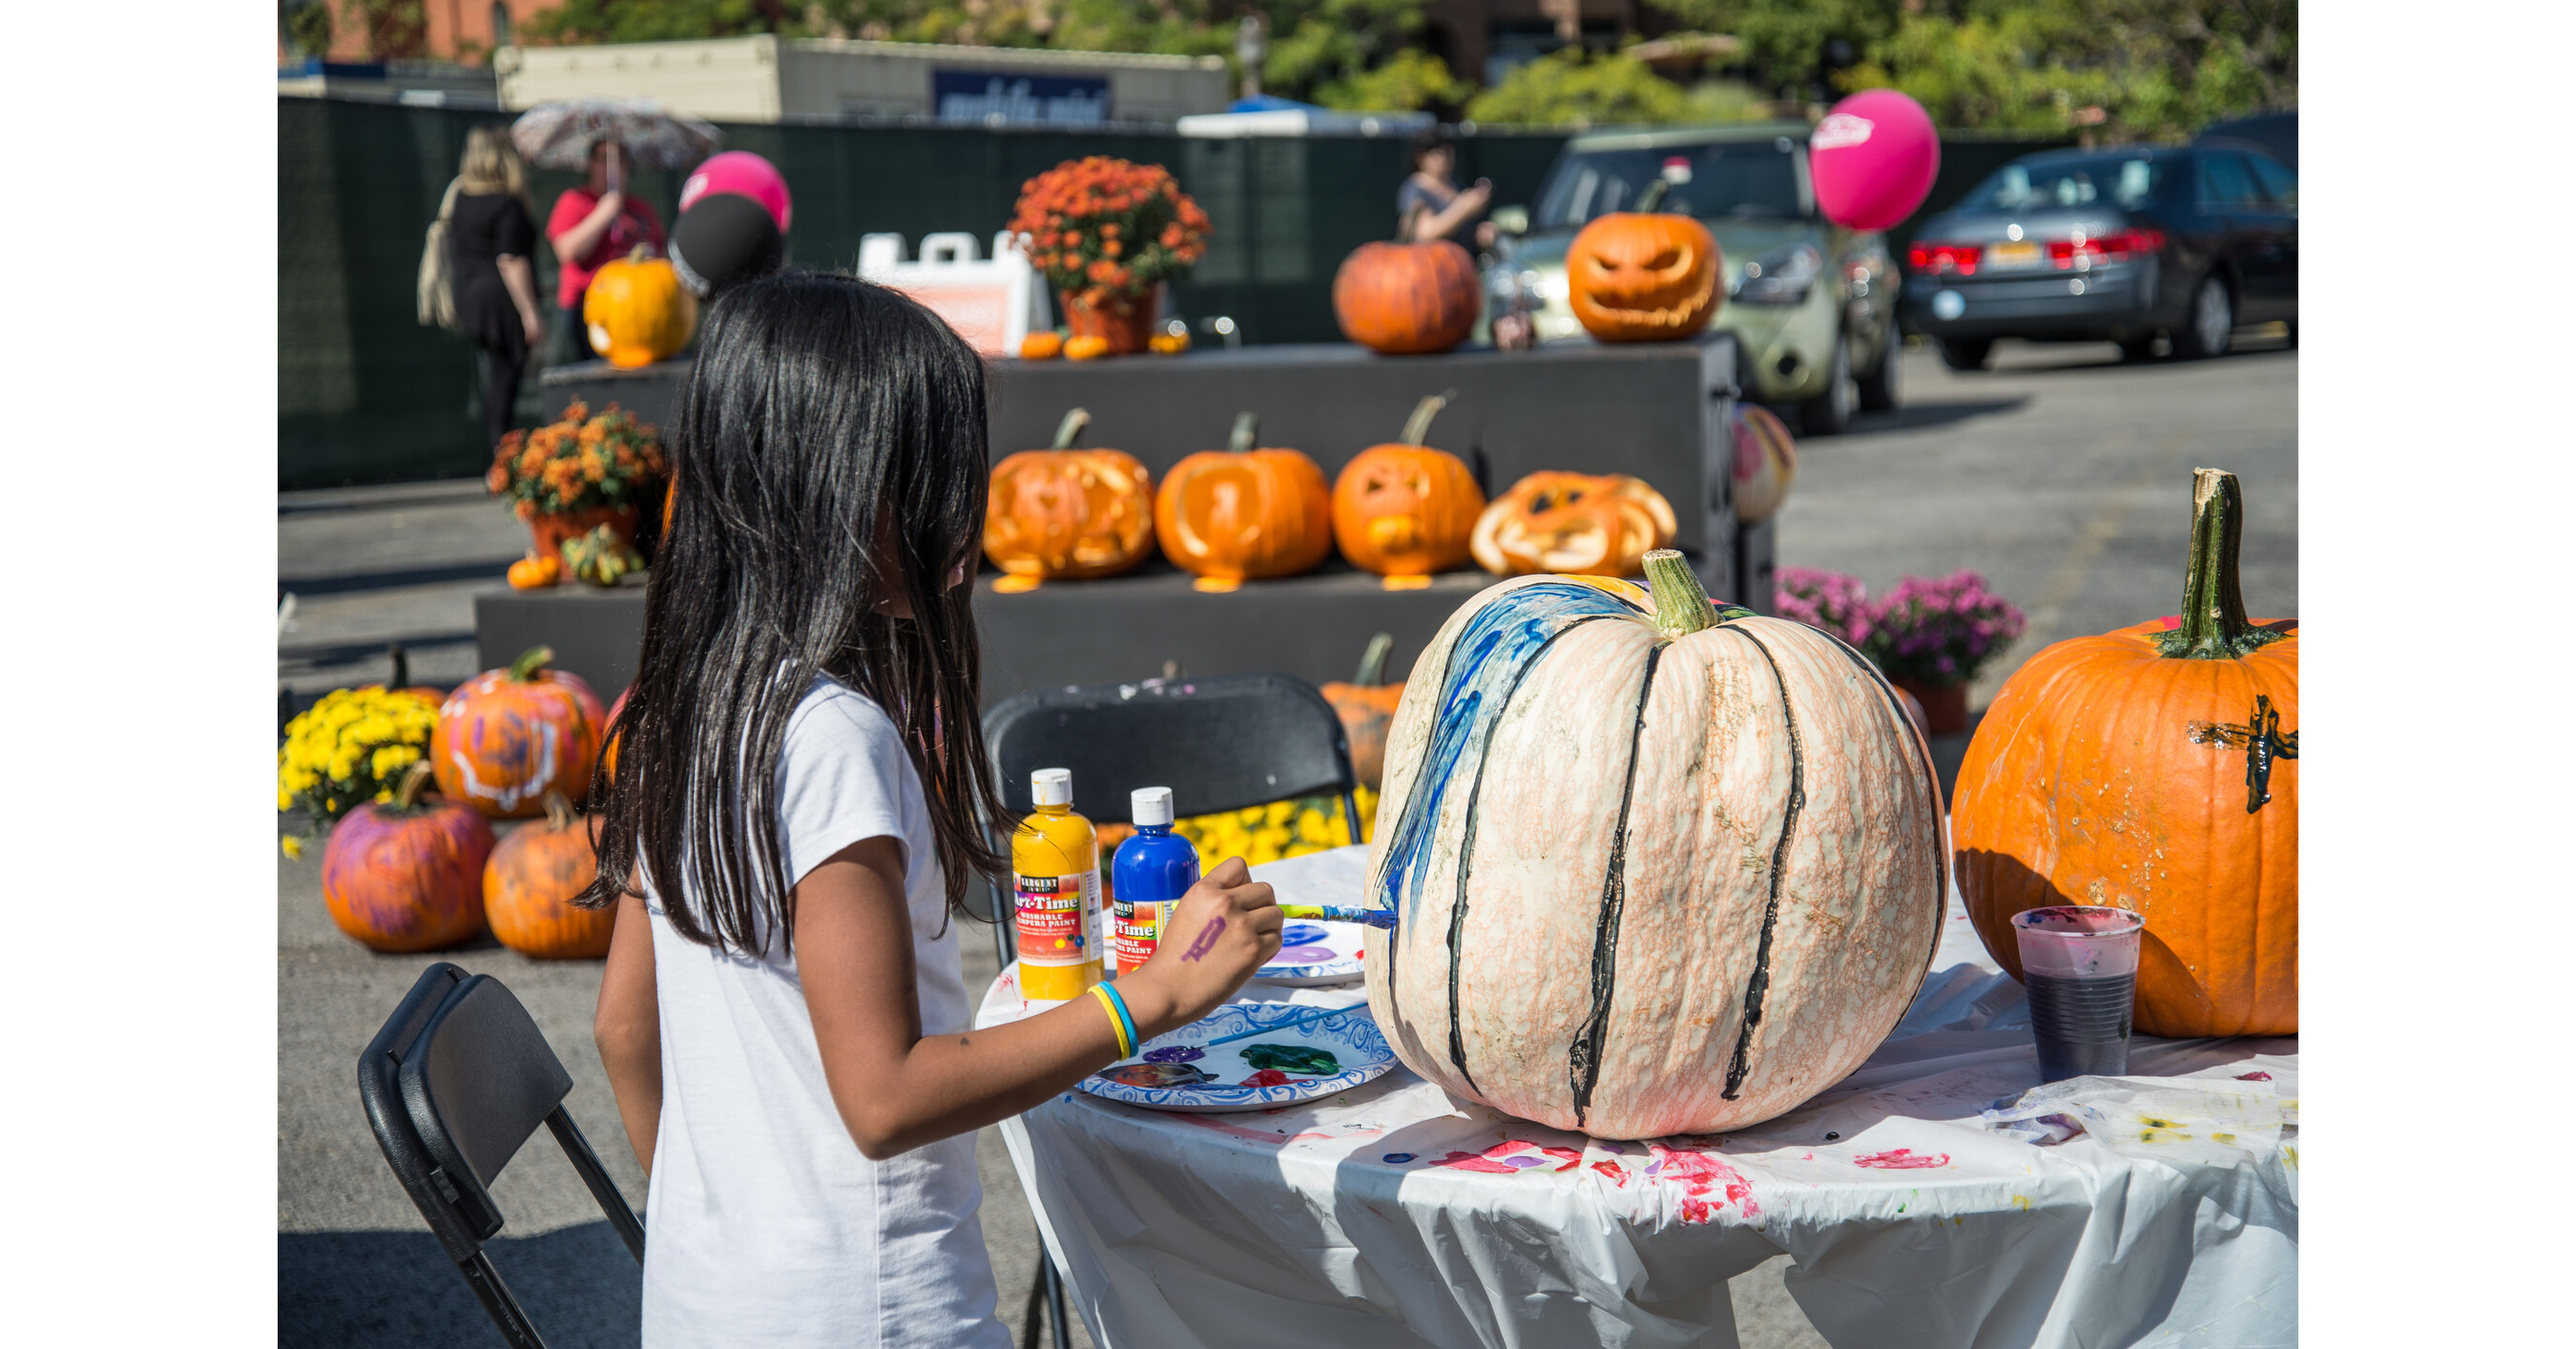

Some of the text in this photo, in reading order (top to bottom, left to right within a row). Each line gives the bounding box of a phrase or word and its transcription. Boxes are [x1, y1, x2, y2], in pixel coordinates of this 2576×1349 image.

[1021, 877, 1057, 887] SARGENT
[1014, 893, 1078, 910] Art-Time
[1020, 912, 1064, 921] WASHABLE
[1049, 919, 1076, 927] PAINT
[1115, 920, 1154, 937] -Time
[1126, 946, 1152, 955] PAINT
